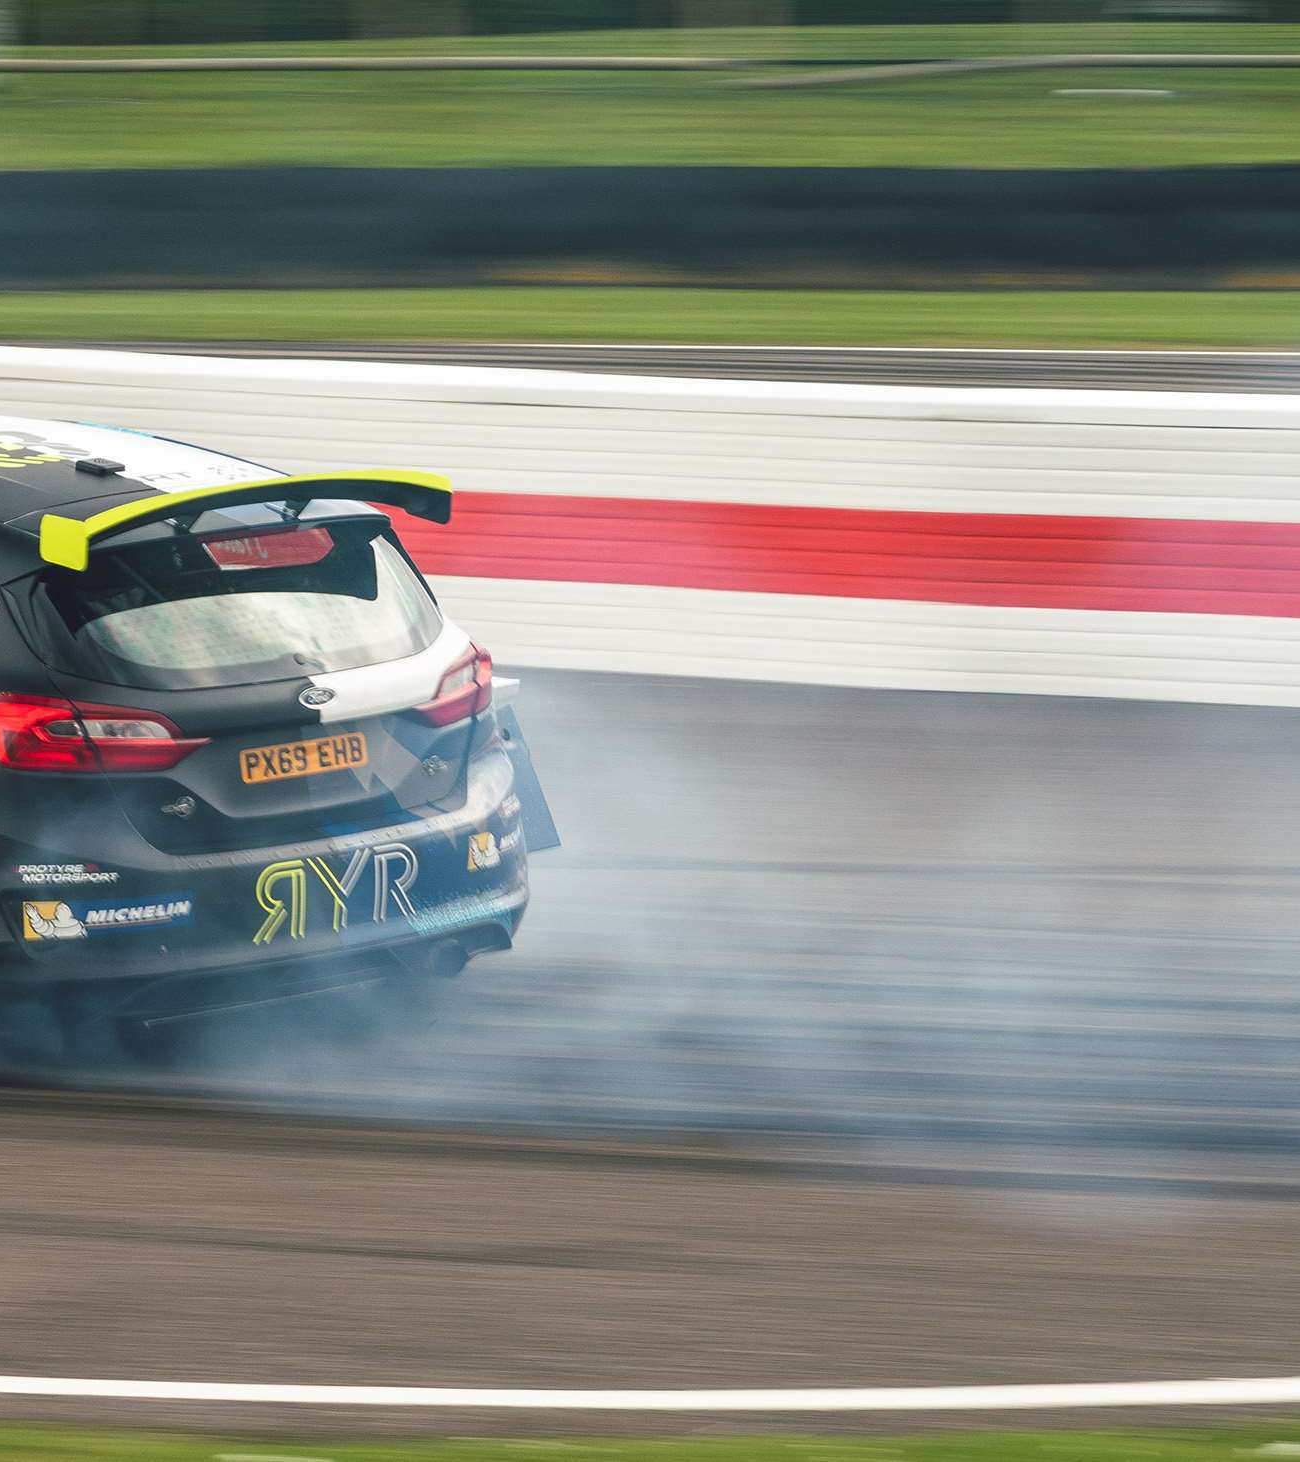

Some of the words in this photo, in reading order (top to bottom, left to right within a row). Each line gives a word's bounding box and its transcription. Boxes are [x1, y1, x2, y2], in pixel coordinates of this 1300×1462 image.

[245, 745, 309, 780] PX69
[316, 735, 363, 768] EHB
[18, 864, 84, 873] PROTYRE
[22, 872, 120, 884] MOTORSPORT
[85, 900, 191, 925] MICHELIN
